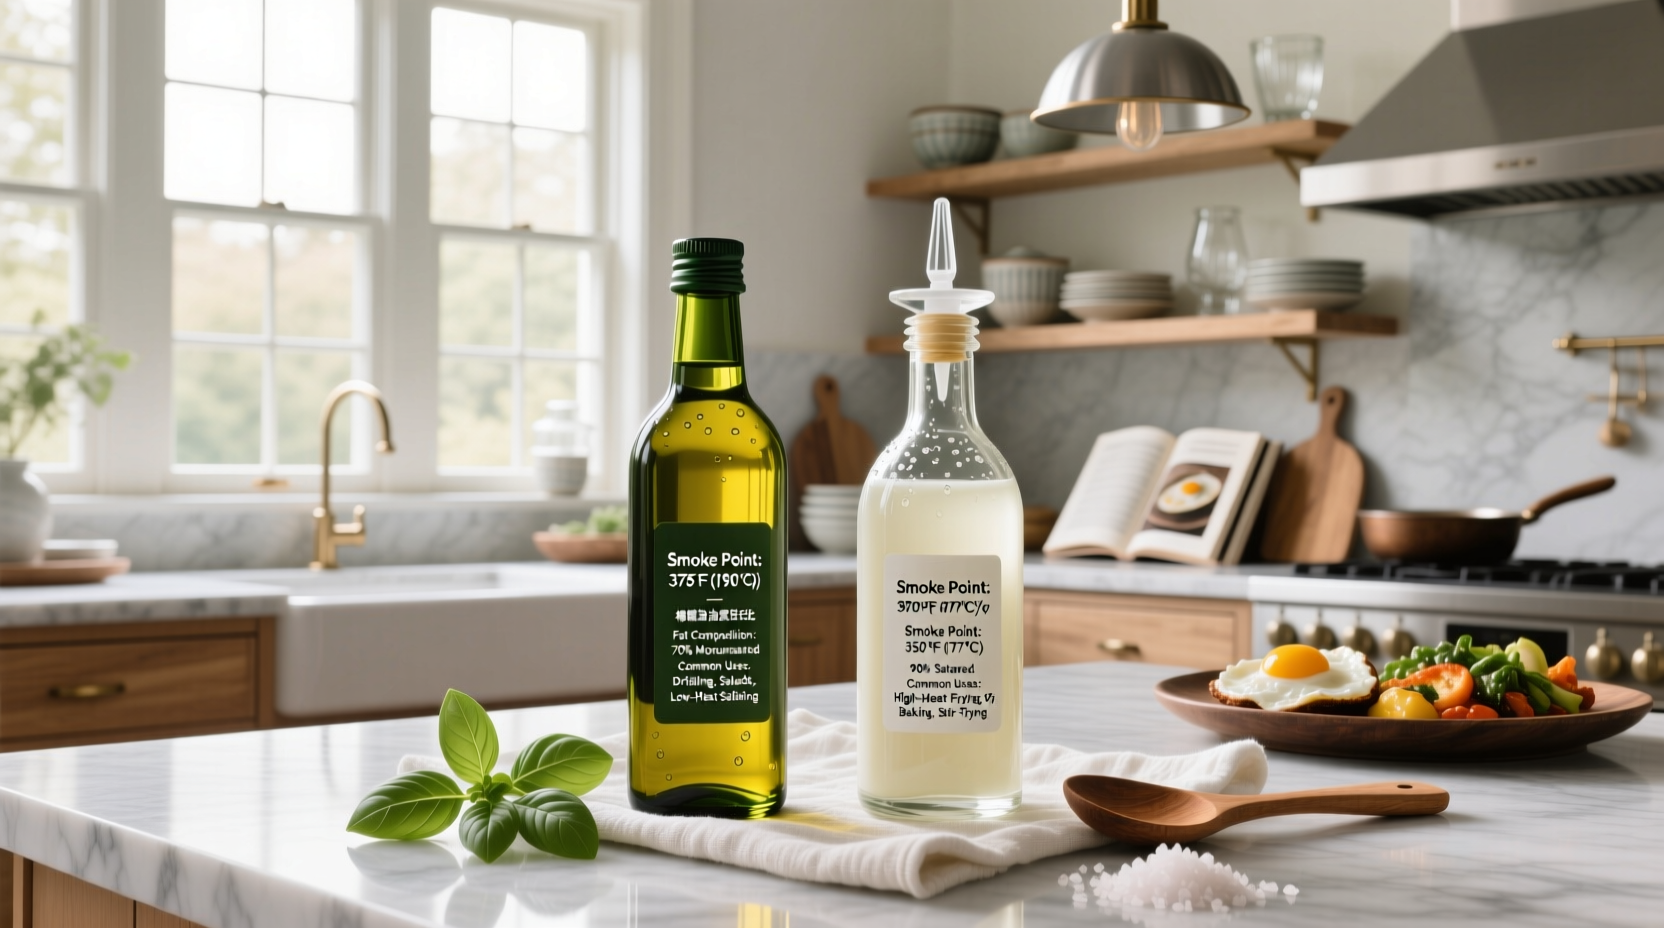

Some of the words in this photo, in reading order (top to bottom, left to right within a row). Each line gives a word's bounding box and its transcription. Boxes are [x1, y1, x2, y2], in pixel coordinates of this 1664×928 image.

[667, 551, 718, 567] Smoke
[721, 551, 762, 567] Point:
[896, 580, 945, 594] Smoke
[948, 580, 991, 594] Point:
[905, 625, 945, 637] Smoke
[948, 625, 982, 637] Point:
